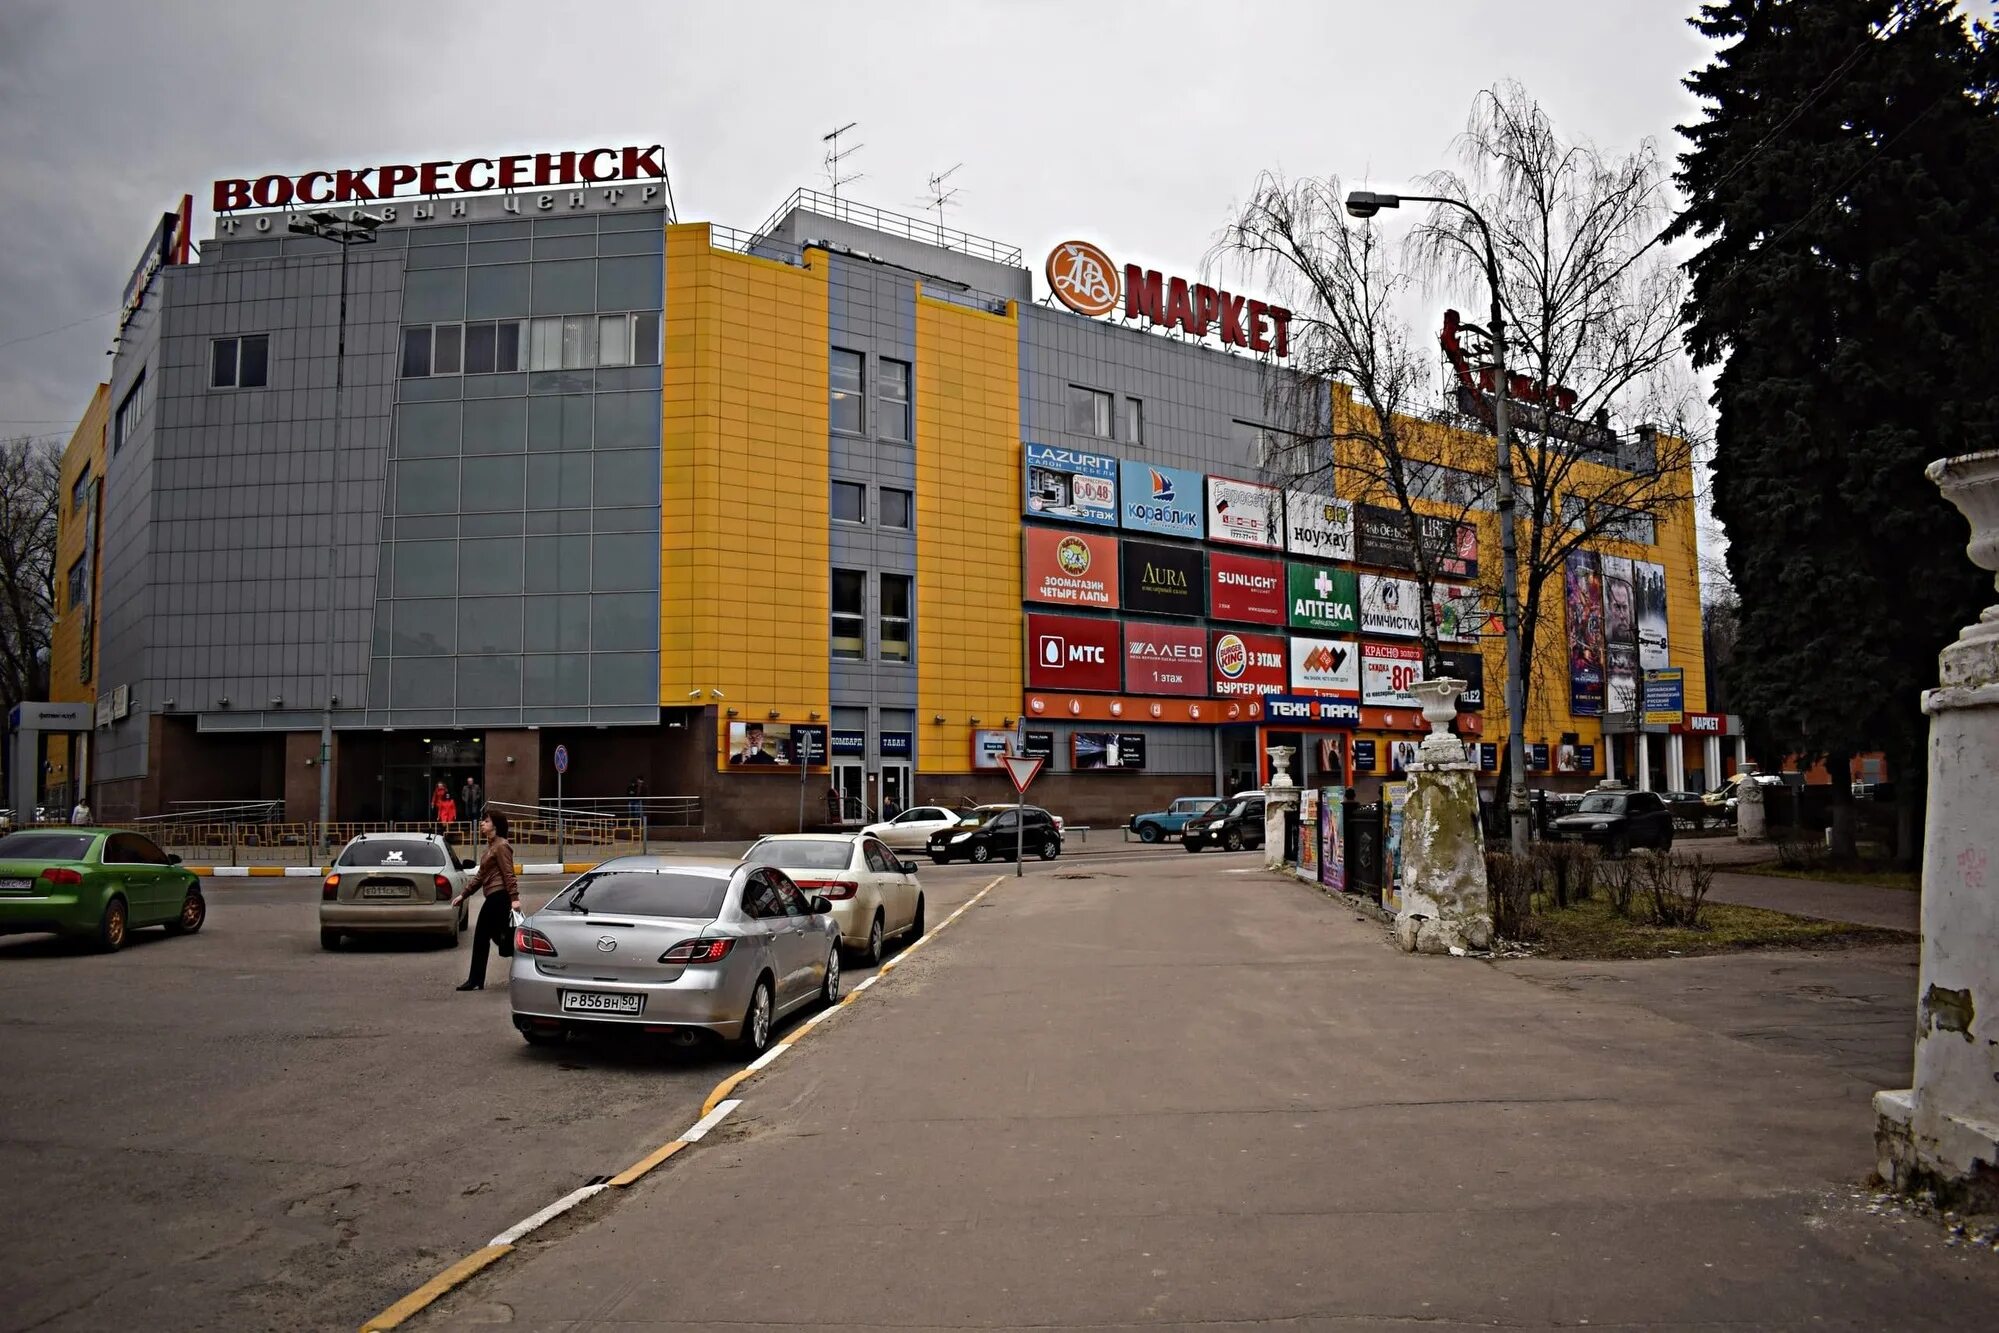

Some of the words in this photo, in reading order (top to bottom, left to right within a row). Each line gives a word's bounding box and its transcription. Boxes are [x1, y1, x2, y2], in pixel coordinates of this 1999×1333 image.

[213, 145, 664, 212] ВОСКРЕСЕНСК
[503, 186, 657, 215] центр
[1124, 263, 1292, 357] МАРКЕТ
[1027, 445, 1114, 470] LAZURIT
[1028, 457, 1062, 468] САЛОН
[1082, 509, 1114, 521] этаж
[1128, 503, 1198, 527] кораблик
[1044, 576, 1104, 591] ЗООМАГАЗИН
[1217, 571, 1278, 590] SUNLIGHT
[1040, 586, 1077, 600] ЧЕТЫРЕ
[1079, 590, 1109, 602] ЛАПЫ
[1294, 598, 1354, 621] АПТЕКА
[1362, 612, 1420, 632] ХИМЧИСТКА
[1069, 644, 1104, 663] МТС
[1143, 642, 1203, 659] АЛЕФ
[1220, 643, 1242, 658] BURGER
[1221, 651, 1243, 668] KING
[1248, 651, 1255, 666] 3
[1257, 652, 1282, 668] ЭТАЖ
[1368, 663, 1390, 673] СКИДКА
[1152, 670, 1158, 682] 1
[1160, 674, 1183, 684] этаж
[1216, 681, 1256, 695] БУРГЕР
[1256, 683, 1284, 695] КИНГ
[1460, 689, 1481, 703] TELE2
[1691, 716, 1719, 731] МАРКЕТ
[882, 738, 906, 748] ТАБАК
